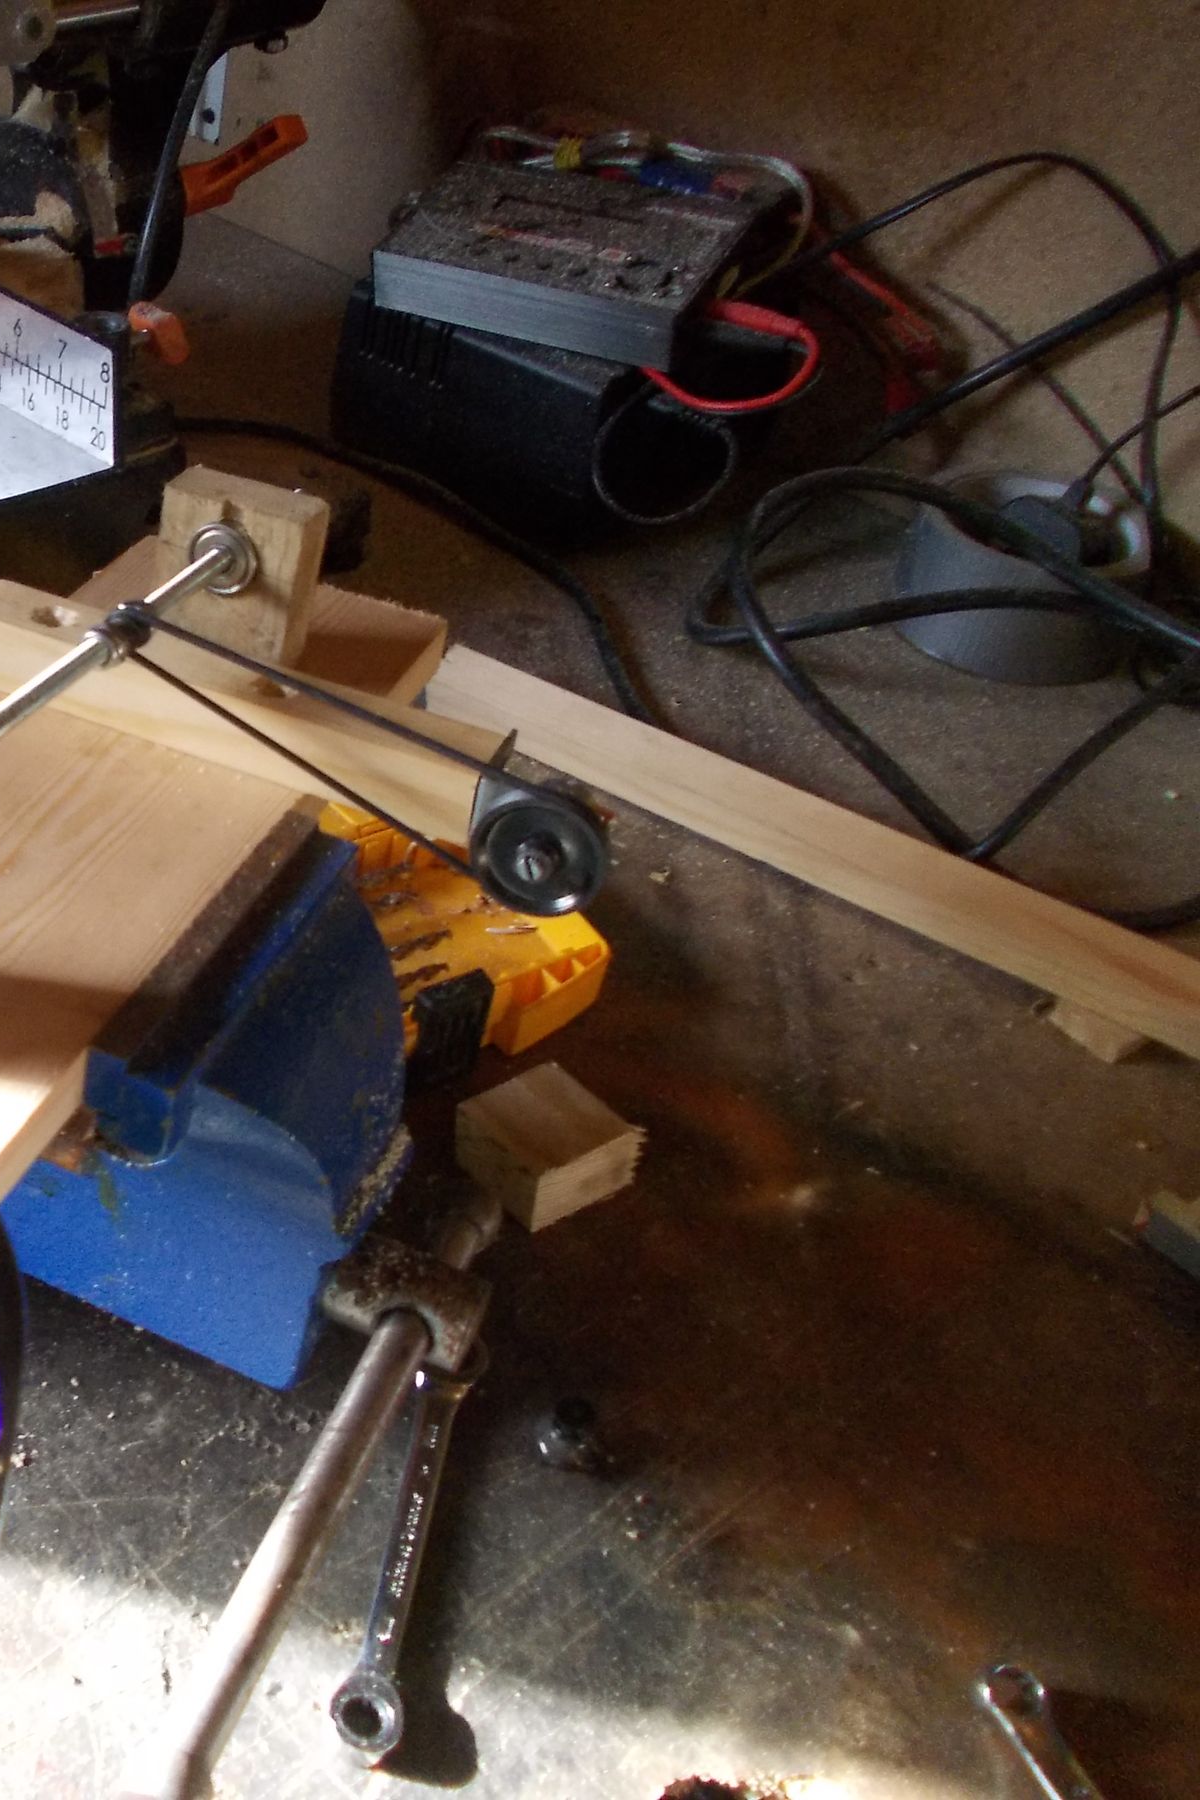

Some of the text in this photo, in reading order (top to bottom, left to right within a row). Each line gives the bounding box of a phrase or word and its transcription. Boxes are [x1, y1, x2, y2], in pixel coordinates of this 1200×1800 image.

[13, 318, 23, 337] 6
[58, 338, 68, 359] 7
[100, 361, 111, 384] 8
[21, 387, 35, 411] 16
[55, 404, 69, 431] 18
[90, 426, 106, 451] 20
